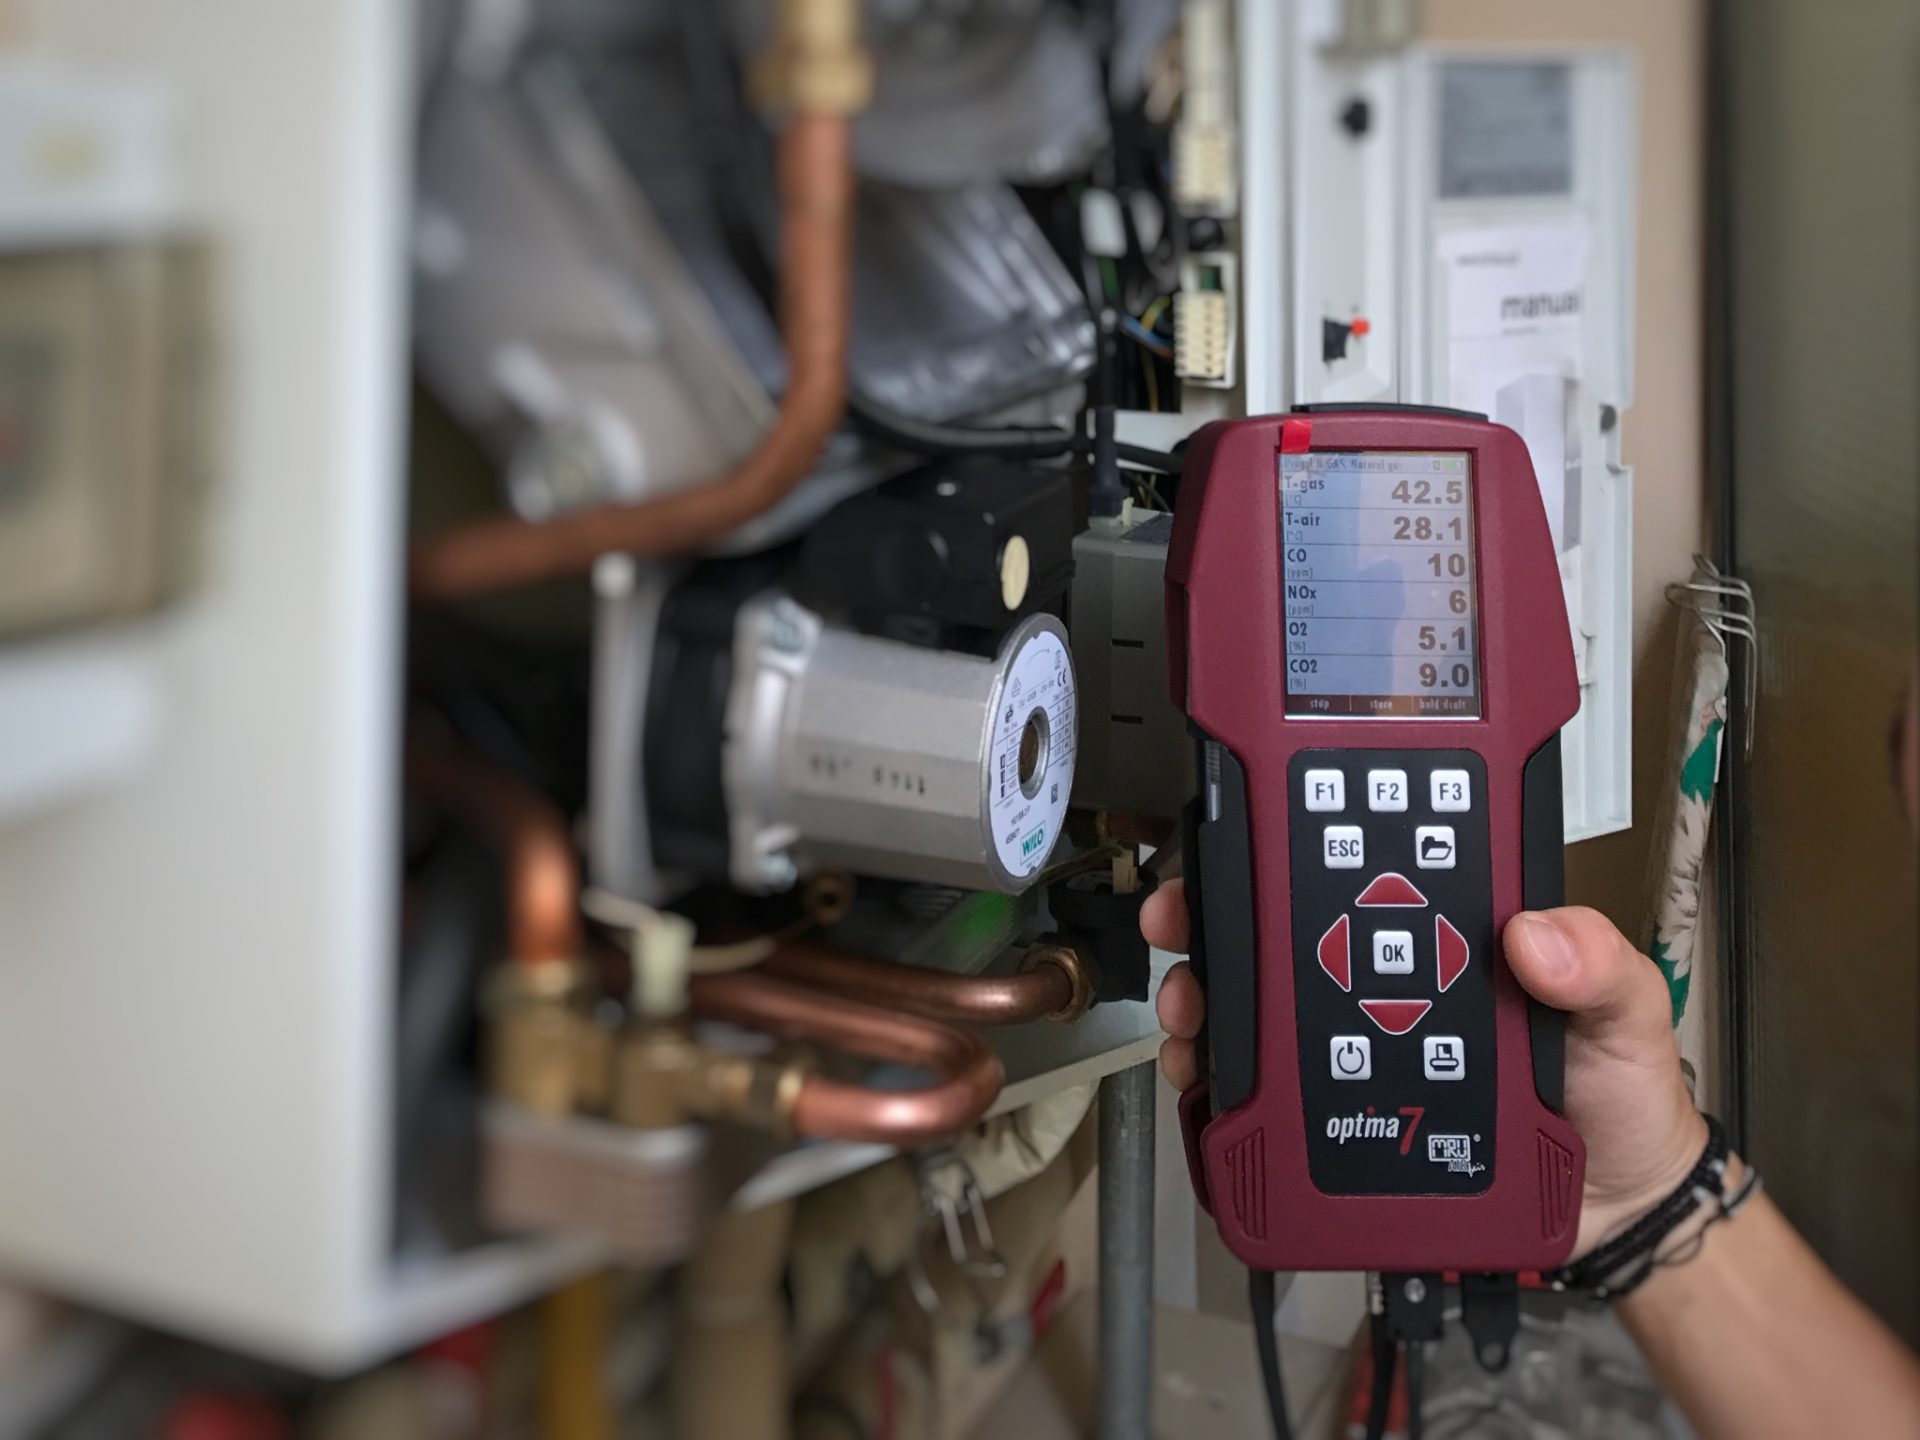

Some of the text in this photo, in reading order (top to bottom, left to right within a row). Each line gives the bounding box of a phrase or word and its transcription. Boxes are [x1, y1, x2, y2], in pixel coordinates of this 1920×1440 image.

[1284, 476, 1325, 493] T-gas
[1391, 480, 1463, 504] 42.5
[1285, 512, 1321, 527] T-air
[1393, 516, 1462, 541] 28.1
[1287, 549, 1307, 563] CO
[1428, 553, 1466, 577] 10
[1288, 585, 1317, 600] NOx
[1449, 590, 1467, 614] 6
[1289, 622, 1308, 636] O2
[1418, 626, 1466, 651] 5.1
[1290, 659, 1318, 674] CO2
[1419, 663, 1470, 688] 9.0
[1315, 782, 1335, 801] F1
[1376, 782, 1400, 801] F2
[1439, 782, 1462, 801] F3
[1022, 828, 1044, 856] WILO
[1328, 839, 1360, 858] ESC
[1382, 943, 1405, 962] OK
